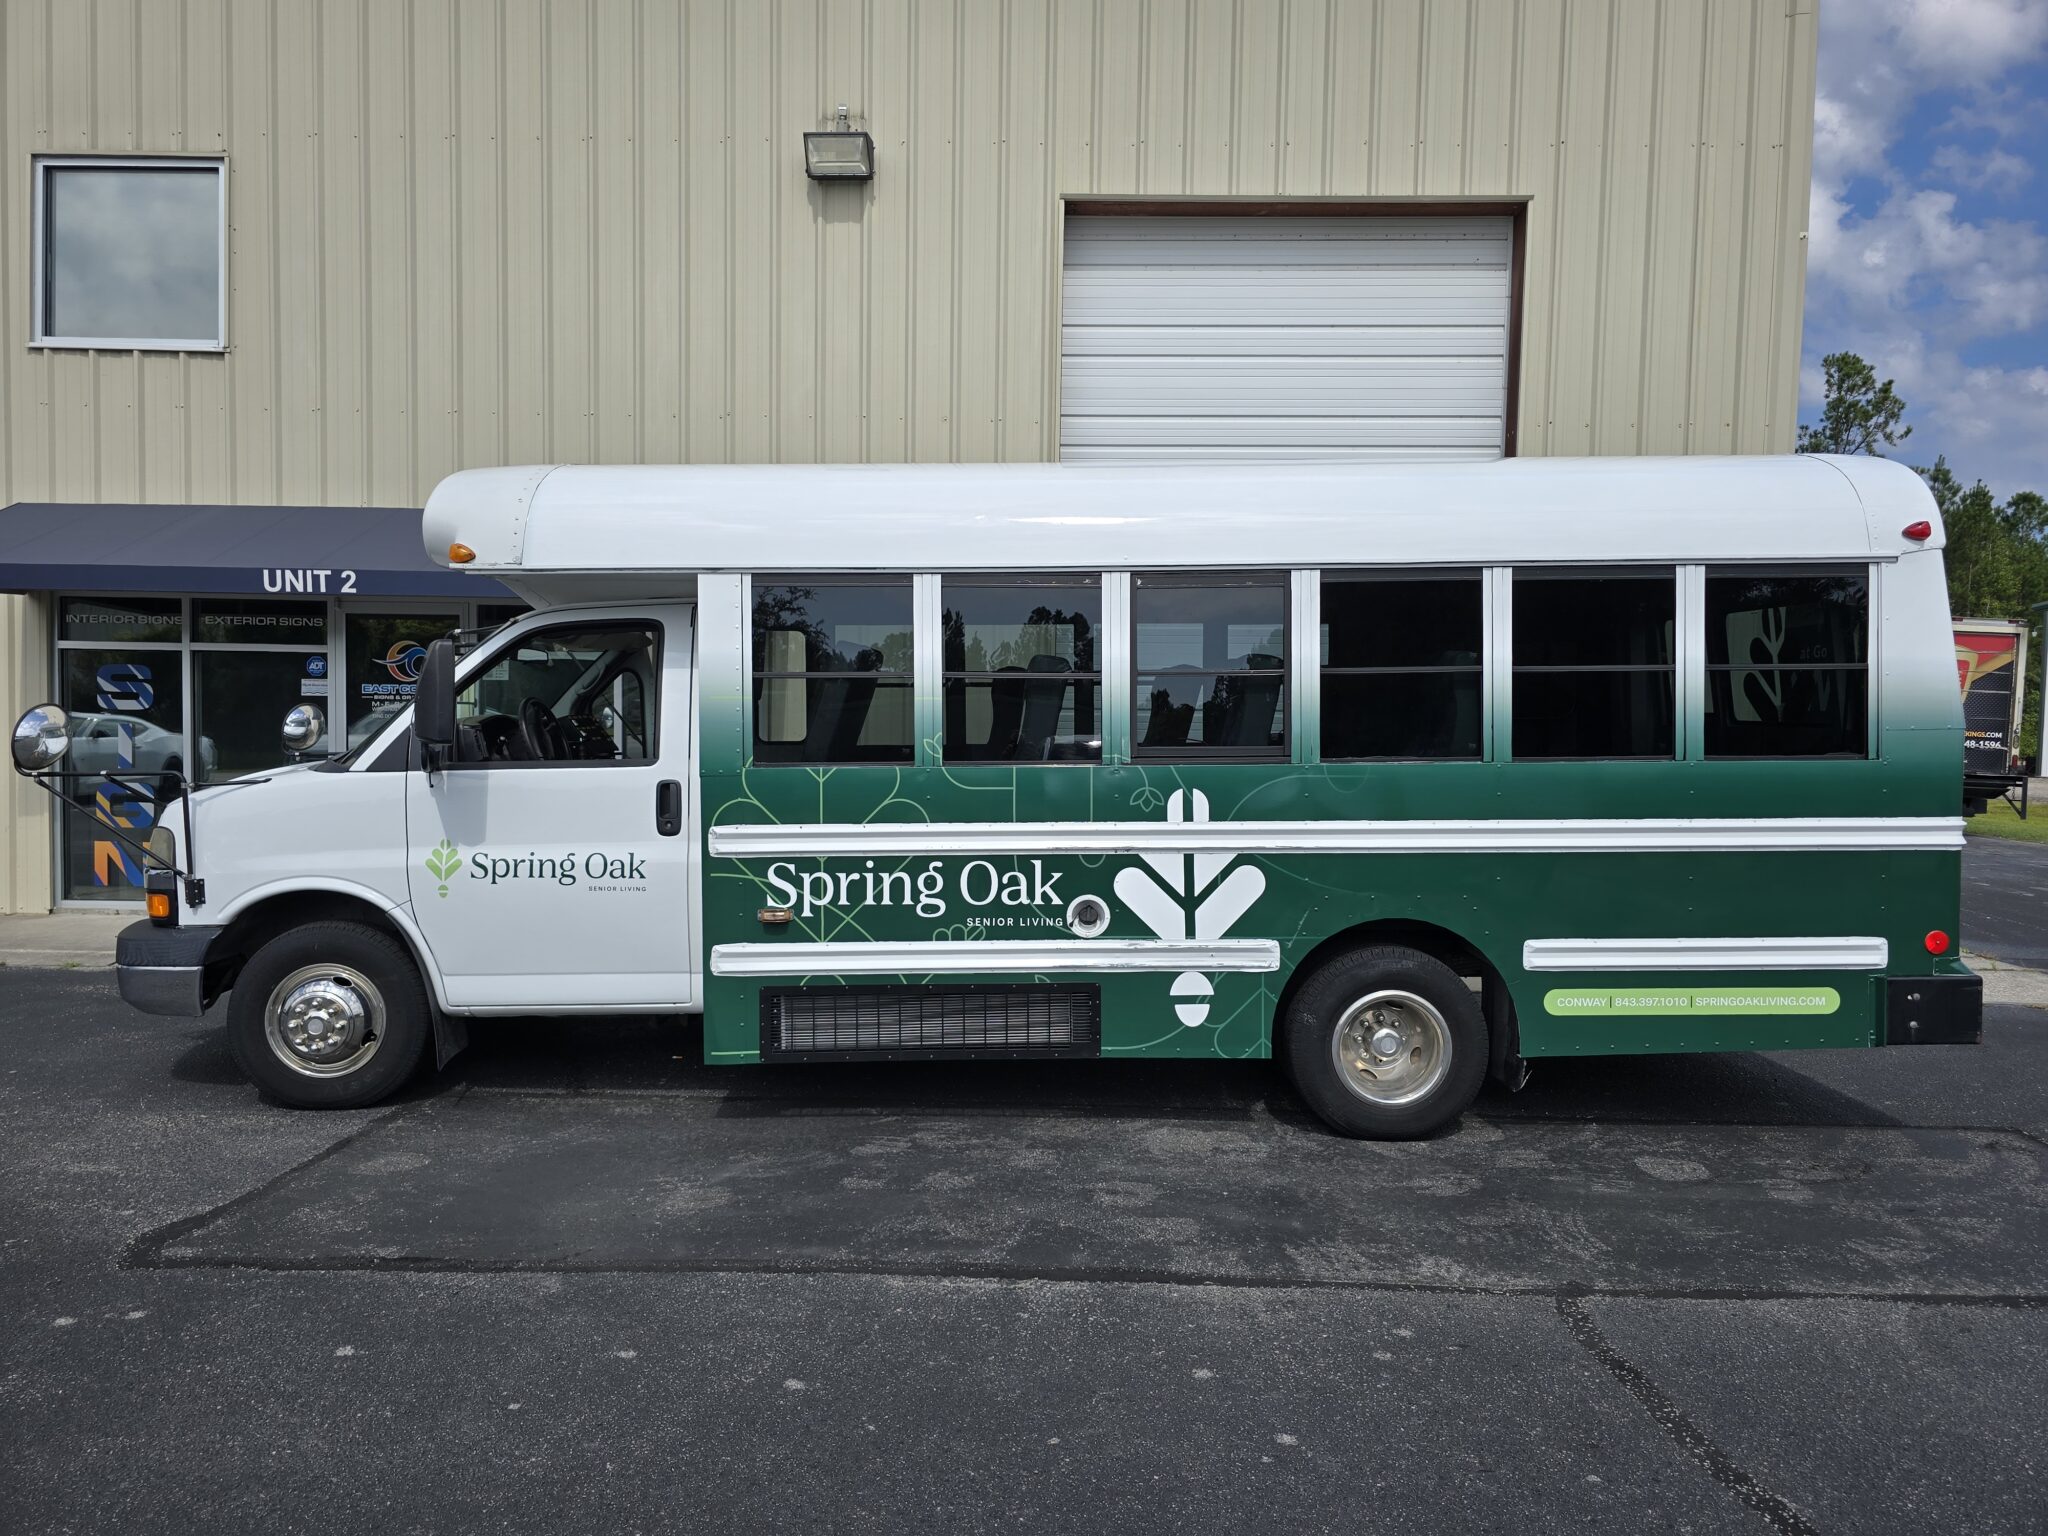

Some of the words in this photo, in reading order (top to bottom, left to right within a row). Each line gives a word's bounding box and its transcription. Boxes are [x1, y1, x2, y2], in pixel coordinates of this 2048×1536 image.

[263, 569, 332, 593] UNIT
[340, 570, 357, 594] 2
[66, 614, 136, 625] INTERIOR
[138, 615, 182, 625] SIGNS
[205, 616, 277, 626] EXTERIOR
[279, 617, 324, 627] SIGNS
[309, 662, 325, 670] ADT
[362, 684, 399, 694] EAST
[1964, 731, 2003, 739] KINGS.COM
[1964, 740, 2002, 749] 48-1596
[470, 851, 577, 886] Spring
[585, 852, 646, 879] Oak
[765, 859, 947, 918] Spring
[959, 859, 1064, 906] Oak
[966, 917, 1014, 927] SENIOR
[1019, 917, 1064, 927] LIVING
[1557, 997, 1608, 1007] CONWAY
[1615, 997, 1688, 1007] 843.397.1010
[1695, 996, 1827, 1007] SPRINGOAKLIVING.COM
